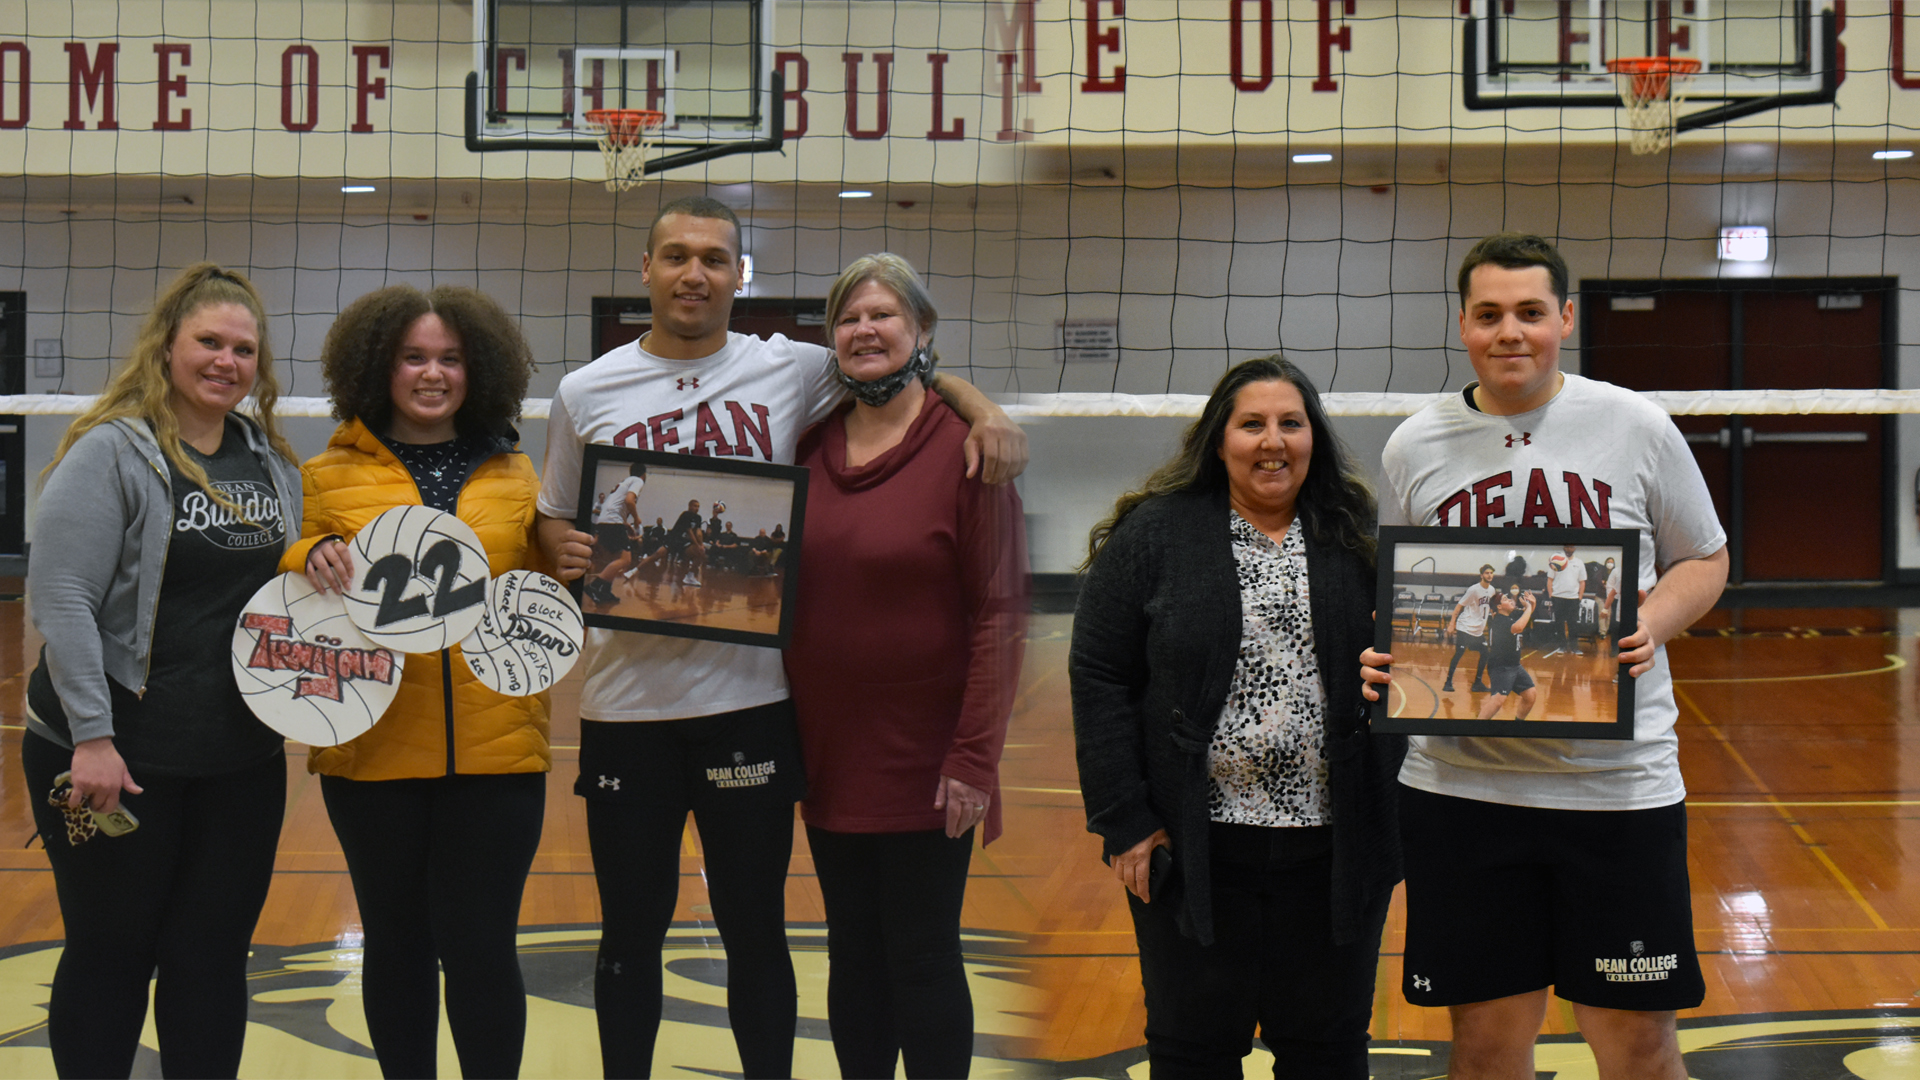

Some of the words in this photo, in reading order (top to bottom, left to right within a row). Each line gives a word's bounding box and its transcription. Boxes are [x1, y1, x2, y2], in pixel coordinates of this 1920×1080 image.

[1230, 0, 1356, 92] OF
[280, 45, 391, 133] OF
[216, 483, 256, 492] DEAN
[1437, 468, 1612, 528] DEAN
[227, 530, 274, 547] COLLEGE
[361, 539, 487, 628] 22
[500, 613, 575, 657] Dean
[706, 768, 733, 781] DEAN
[734, 760, 776, 779] COLLEGE
[1595, 958, 1627, 973] DEAN
[1630, 954, 1678, 973] COLLEGE
[1607, 972, 1668, 981] VOLLEYBALL
